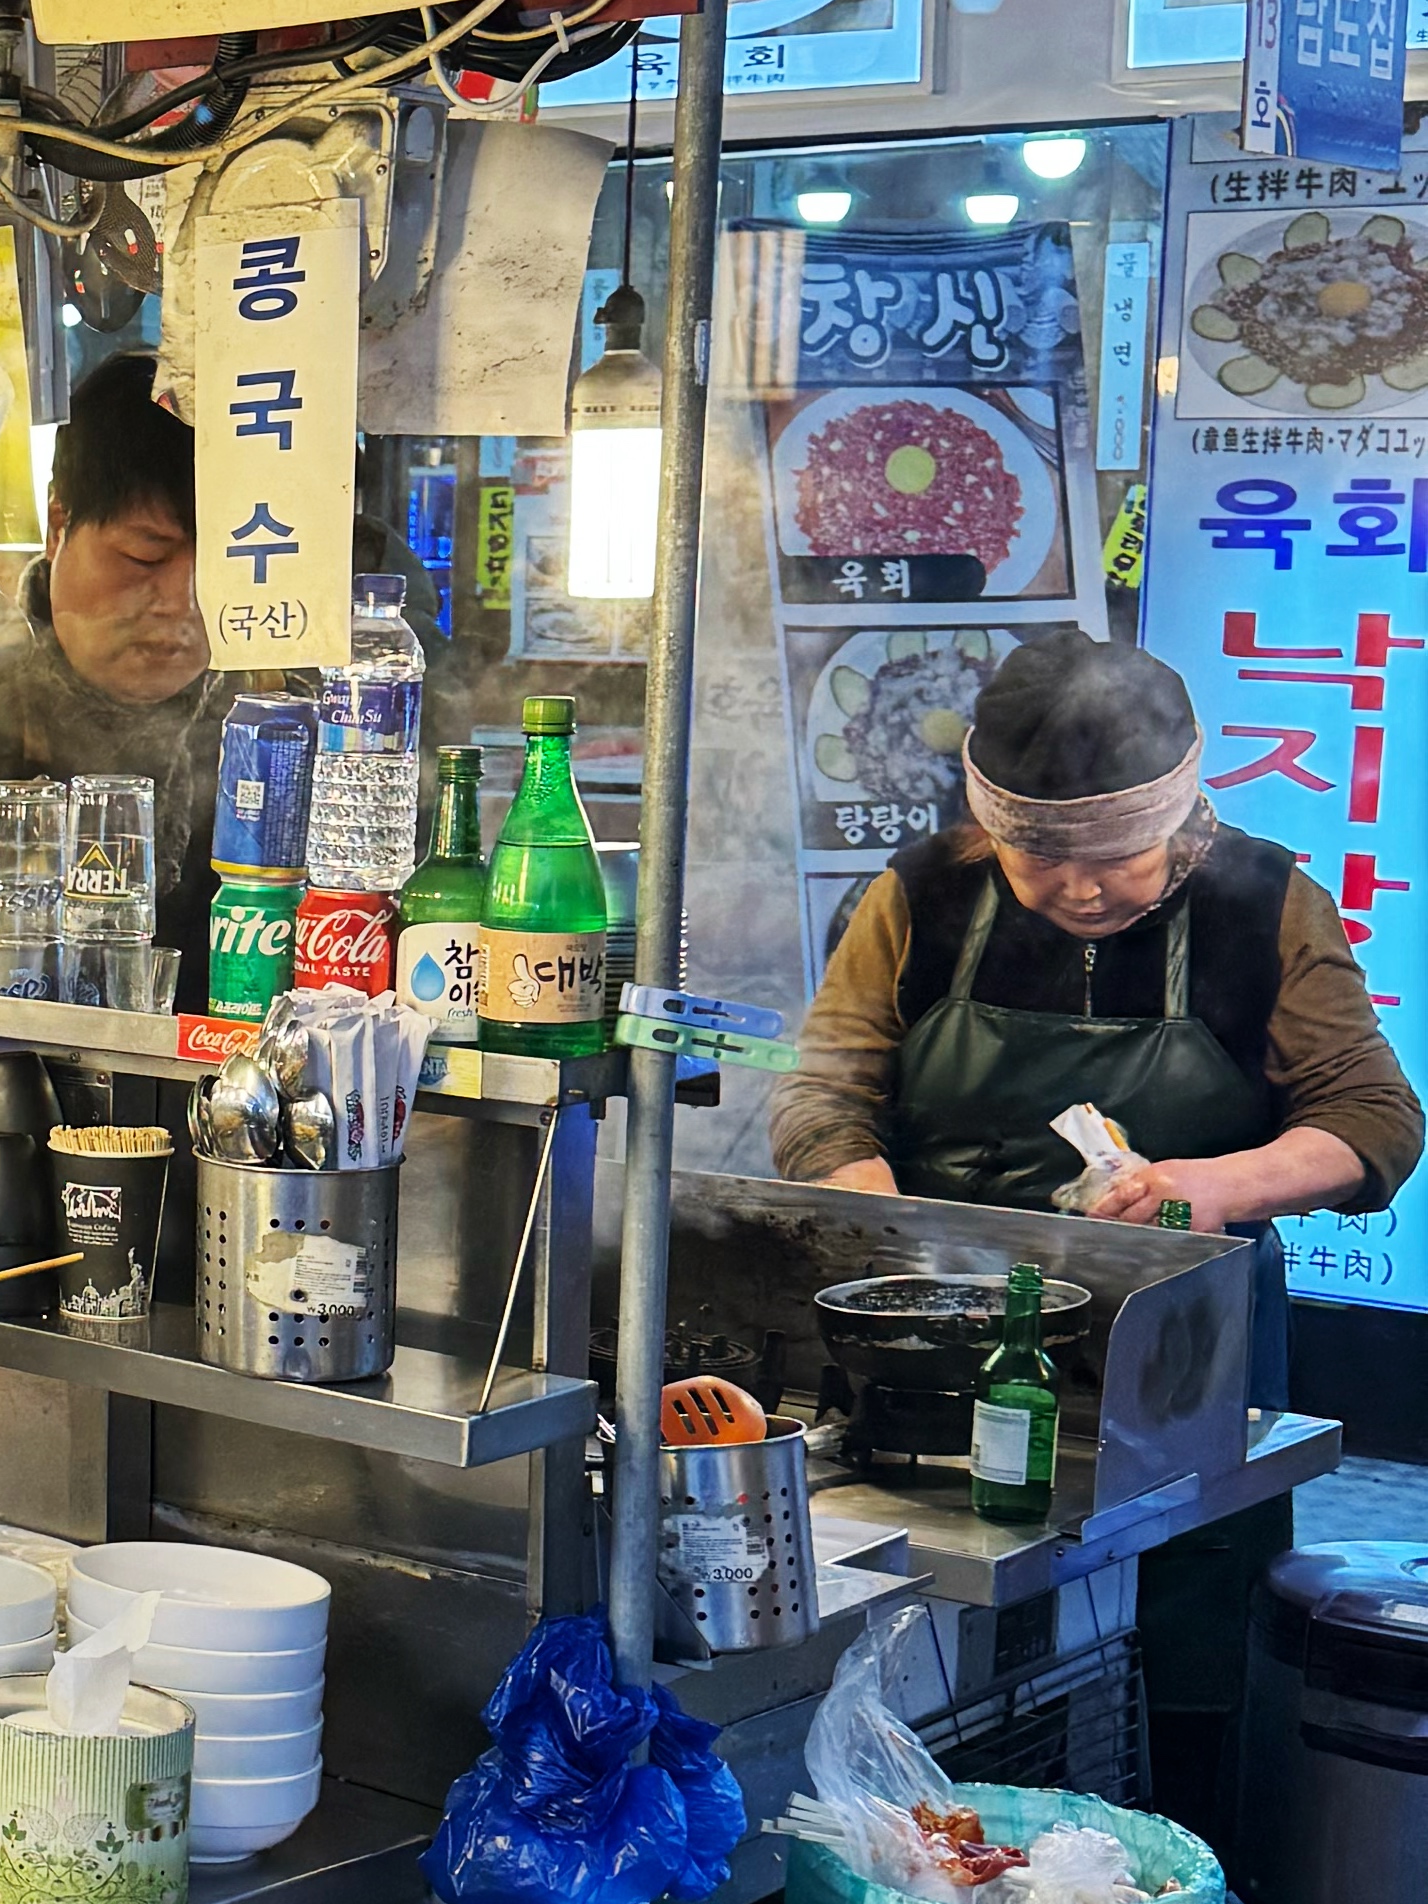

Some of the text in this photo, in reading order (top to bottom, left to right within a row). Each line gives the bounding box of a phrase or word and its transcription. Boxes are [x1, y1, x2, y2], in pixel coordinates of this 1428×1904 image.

[1251, 81, 1272, 128] 호
[798, 264, 1008, 372] 창신
[225, 234, 307, 585] 콩국수
[1199, 477, 1428, 573] 육회
[832, 558, 910, 599] 육회
[217, 598, 309, 644] (국산)
[834, 803, 939, 849] 탕탕이
[322, 965, 372, 979] TASTE
